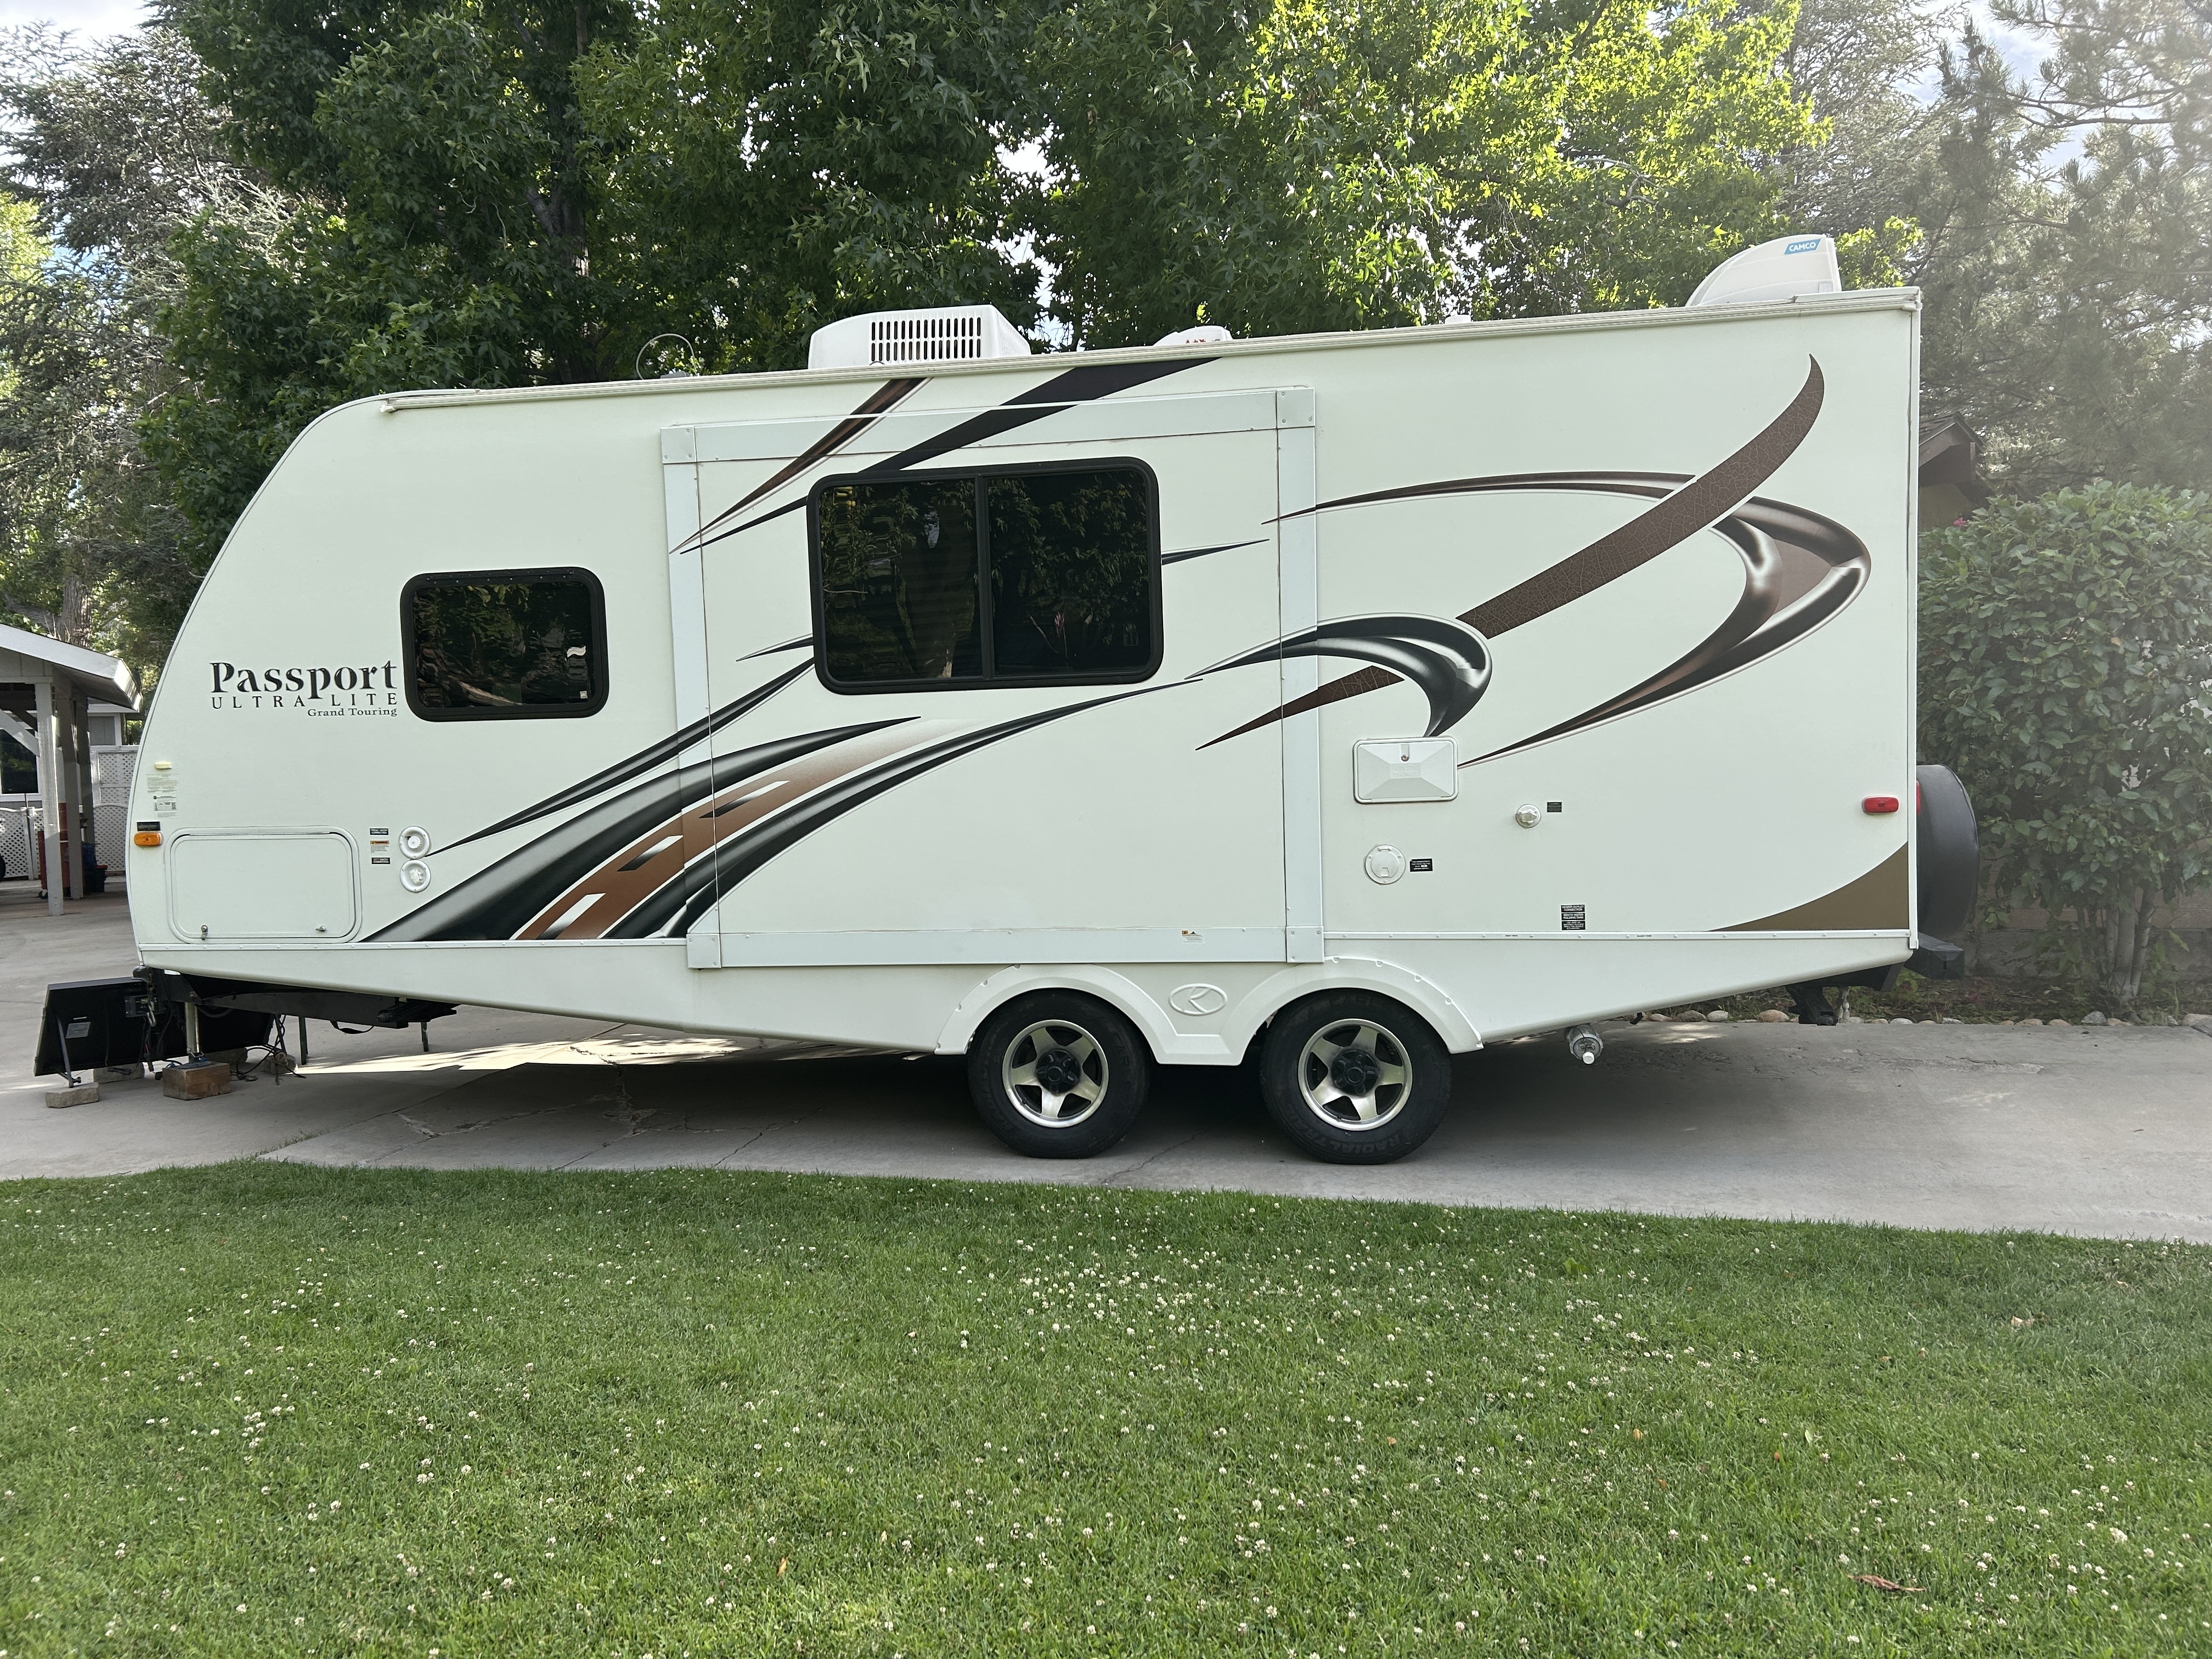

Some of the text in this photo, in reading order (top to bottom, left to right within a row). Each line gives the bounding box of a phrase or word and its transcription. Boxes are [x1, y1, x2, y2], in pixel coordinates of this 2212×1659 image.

[1789, 242, 1816, 251] CAMCO
[210, 660, 397, 699] Passport
[212, 693, 397, 709] ULTRA LITE
[308, 707, 397, 717] Grand Touring
